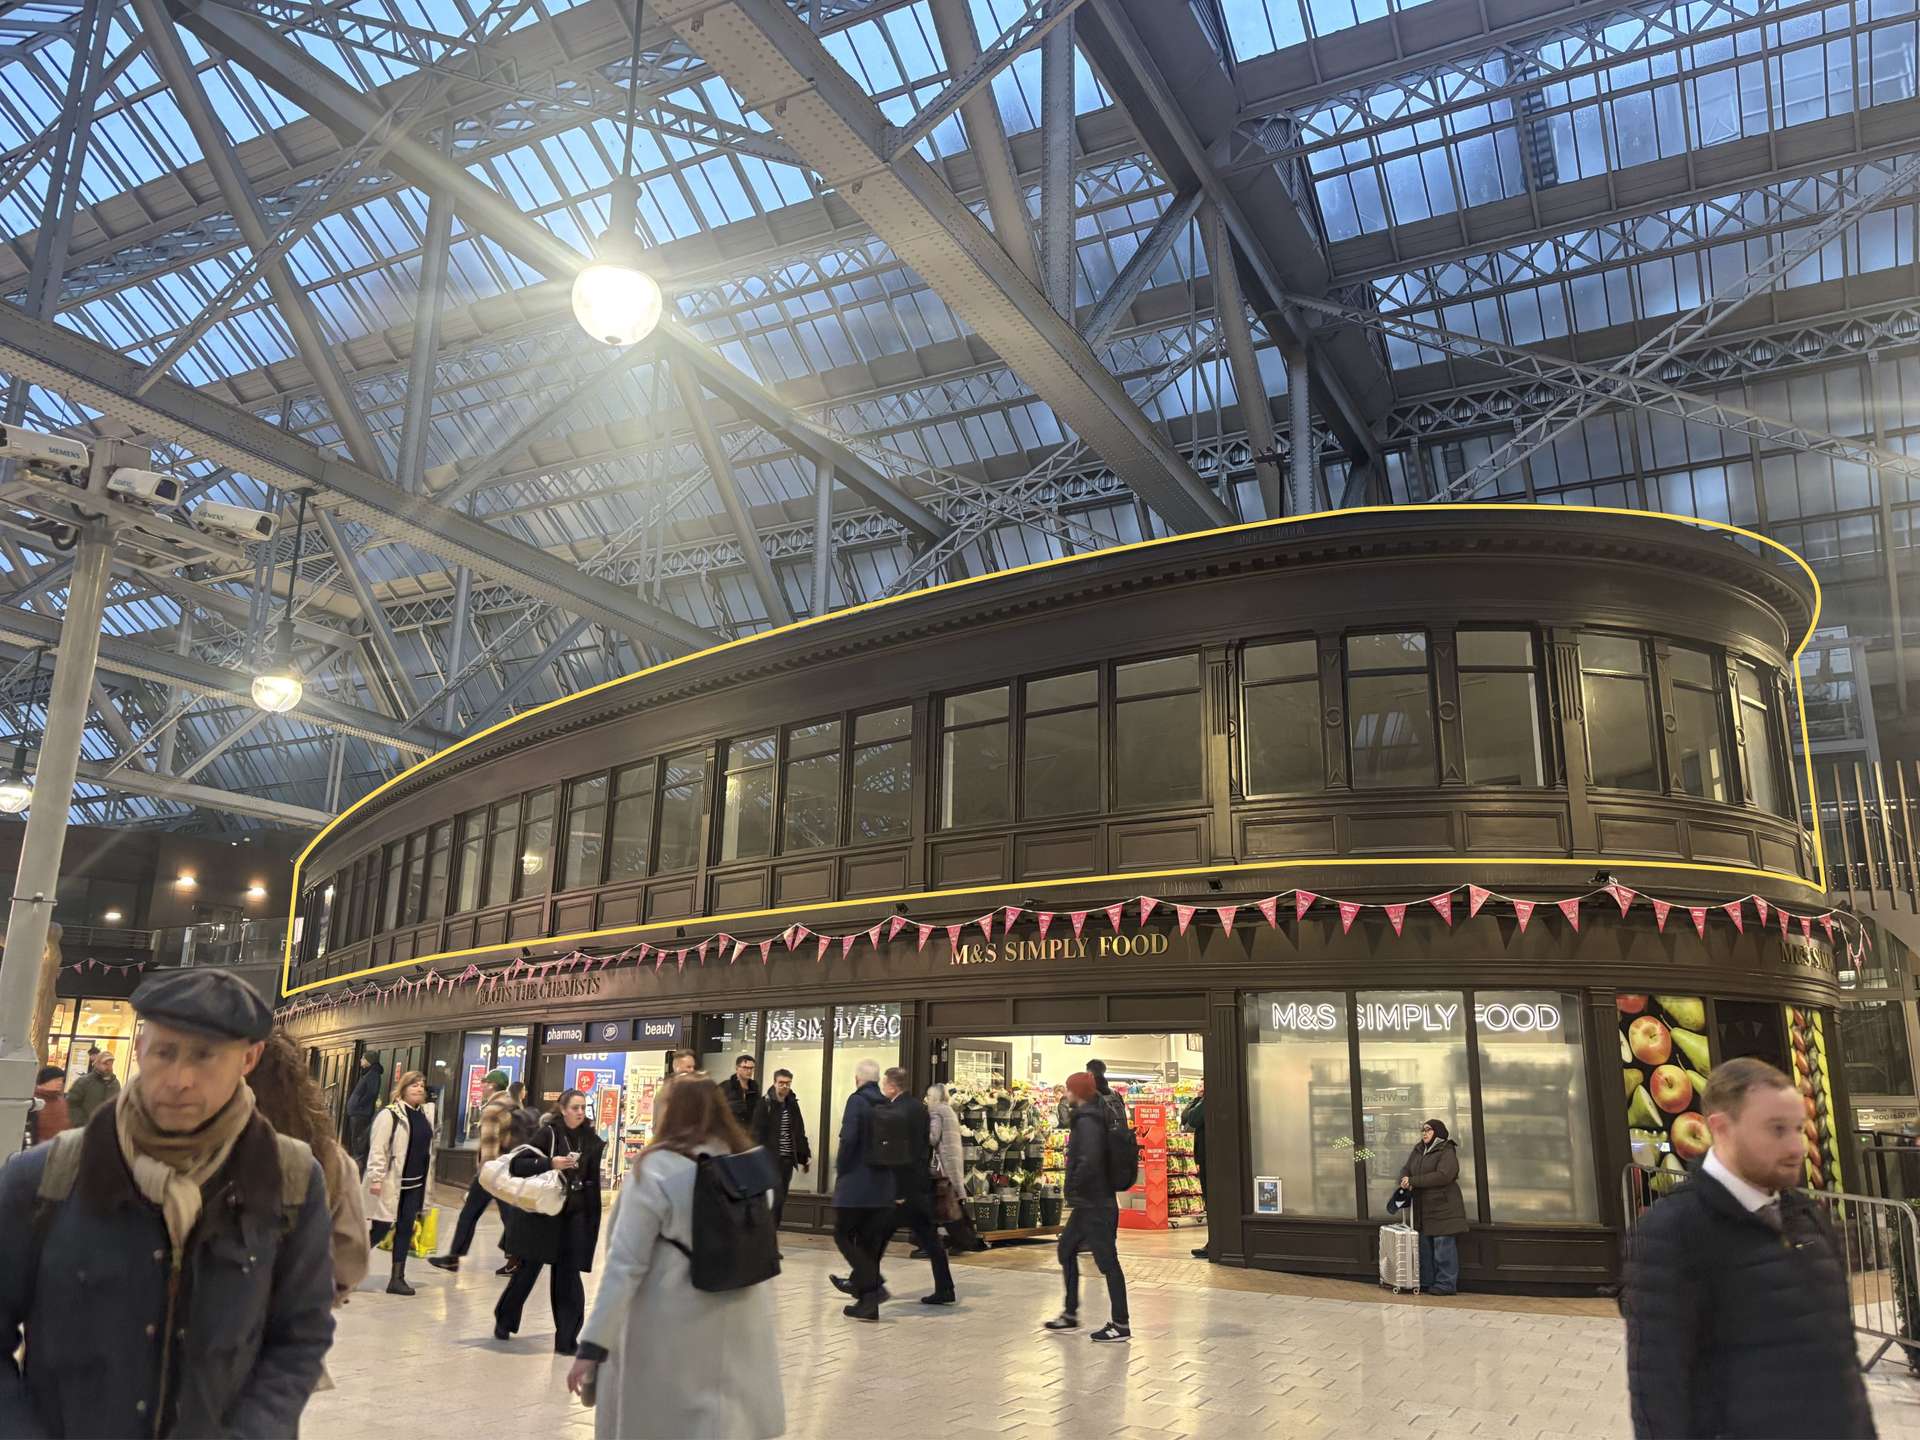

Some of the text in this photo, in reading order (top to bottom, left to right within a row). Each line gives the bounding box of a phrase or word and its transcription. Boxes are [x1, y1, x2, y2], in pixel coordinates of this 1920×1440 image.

[48, 446, 81, 459] SIEMENS
[950, 933, 1169, 965] M&S SIMPLY FOOD
[514, 983, 538, 1001] THE
[540, 977, 601, 999] CHEMISTS
[1272, 1003, 1336, 1030] M&S
[546, 1028, 582, 1042] pharmacy
[645, 1021, 675, 1037] beauty
